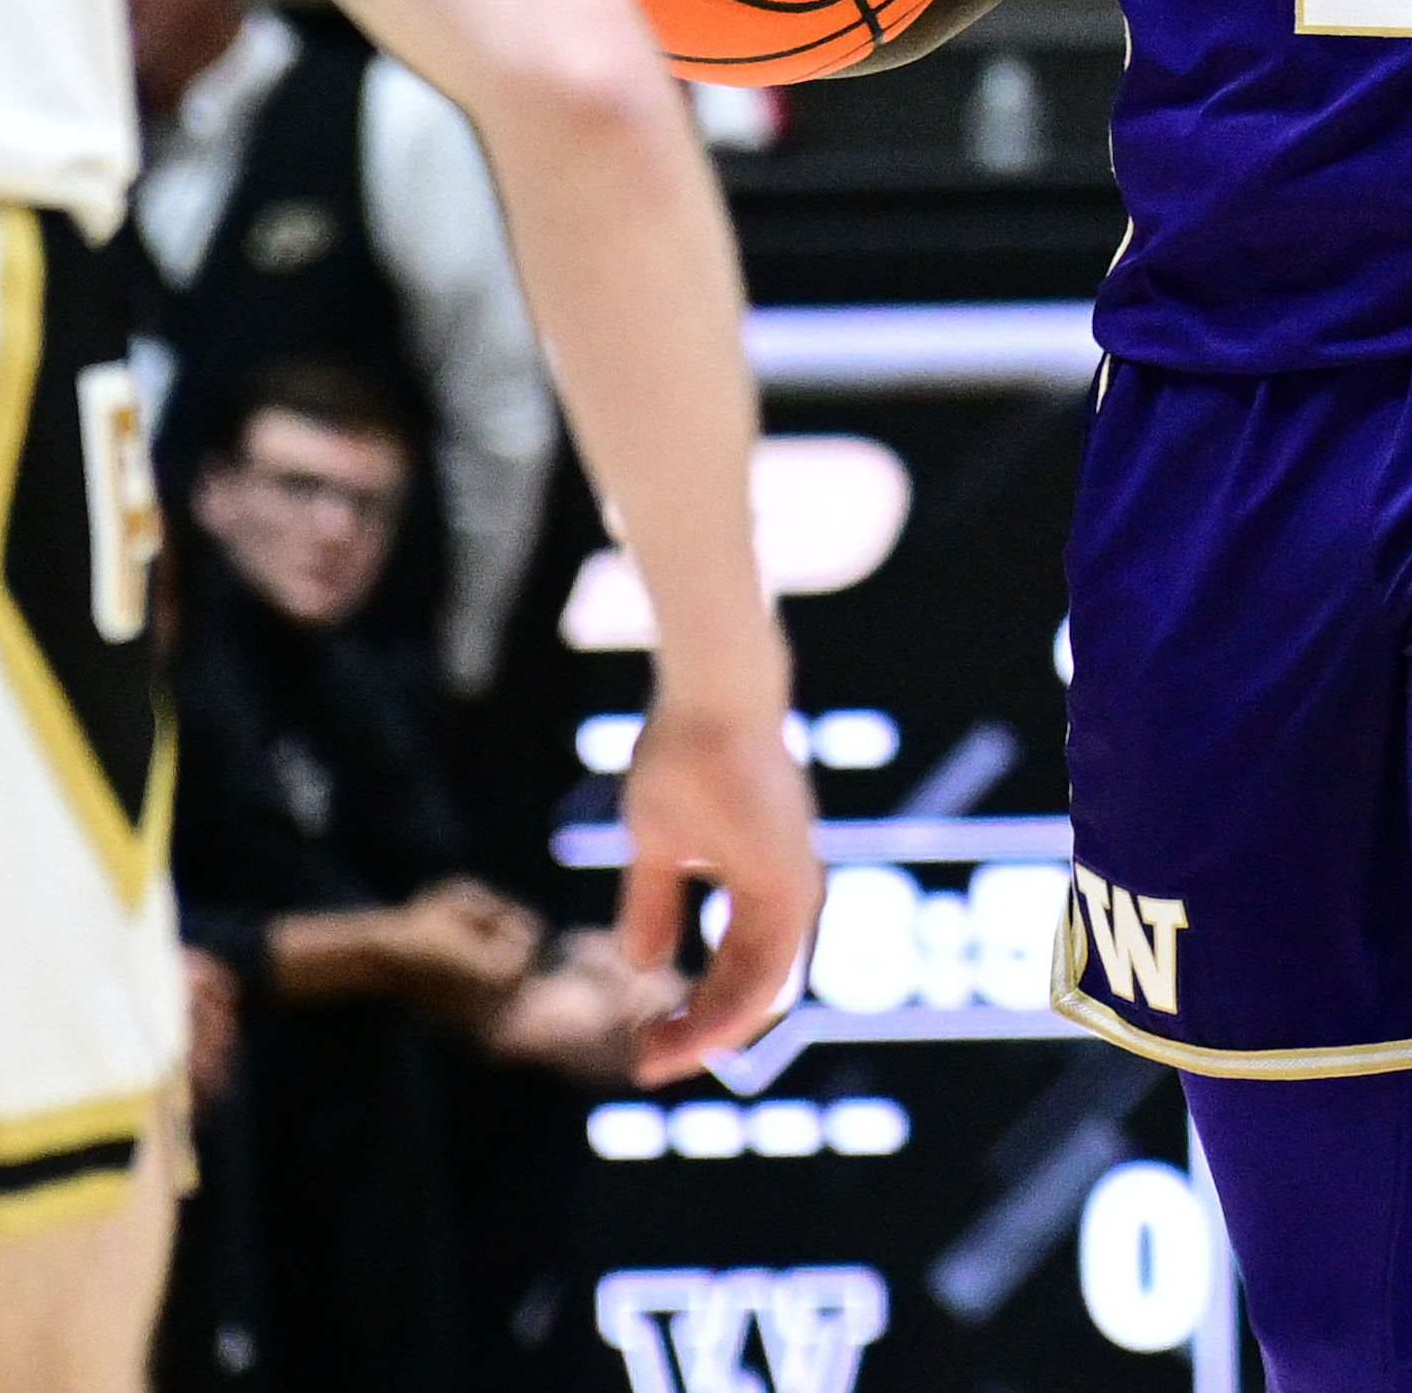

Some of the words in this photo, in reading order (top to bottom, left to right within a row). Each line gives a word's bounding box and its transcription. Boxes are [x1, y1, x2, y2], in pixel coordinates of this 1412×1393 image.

[1075, 860, 1189, 1015] W
[595, 1265, 888, 1393] W
[1078, 1159, 1212, 1353] 0
